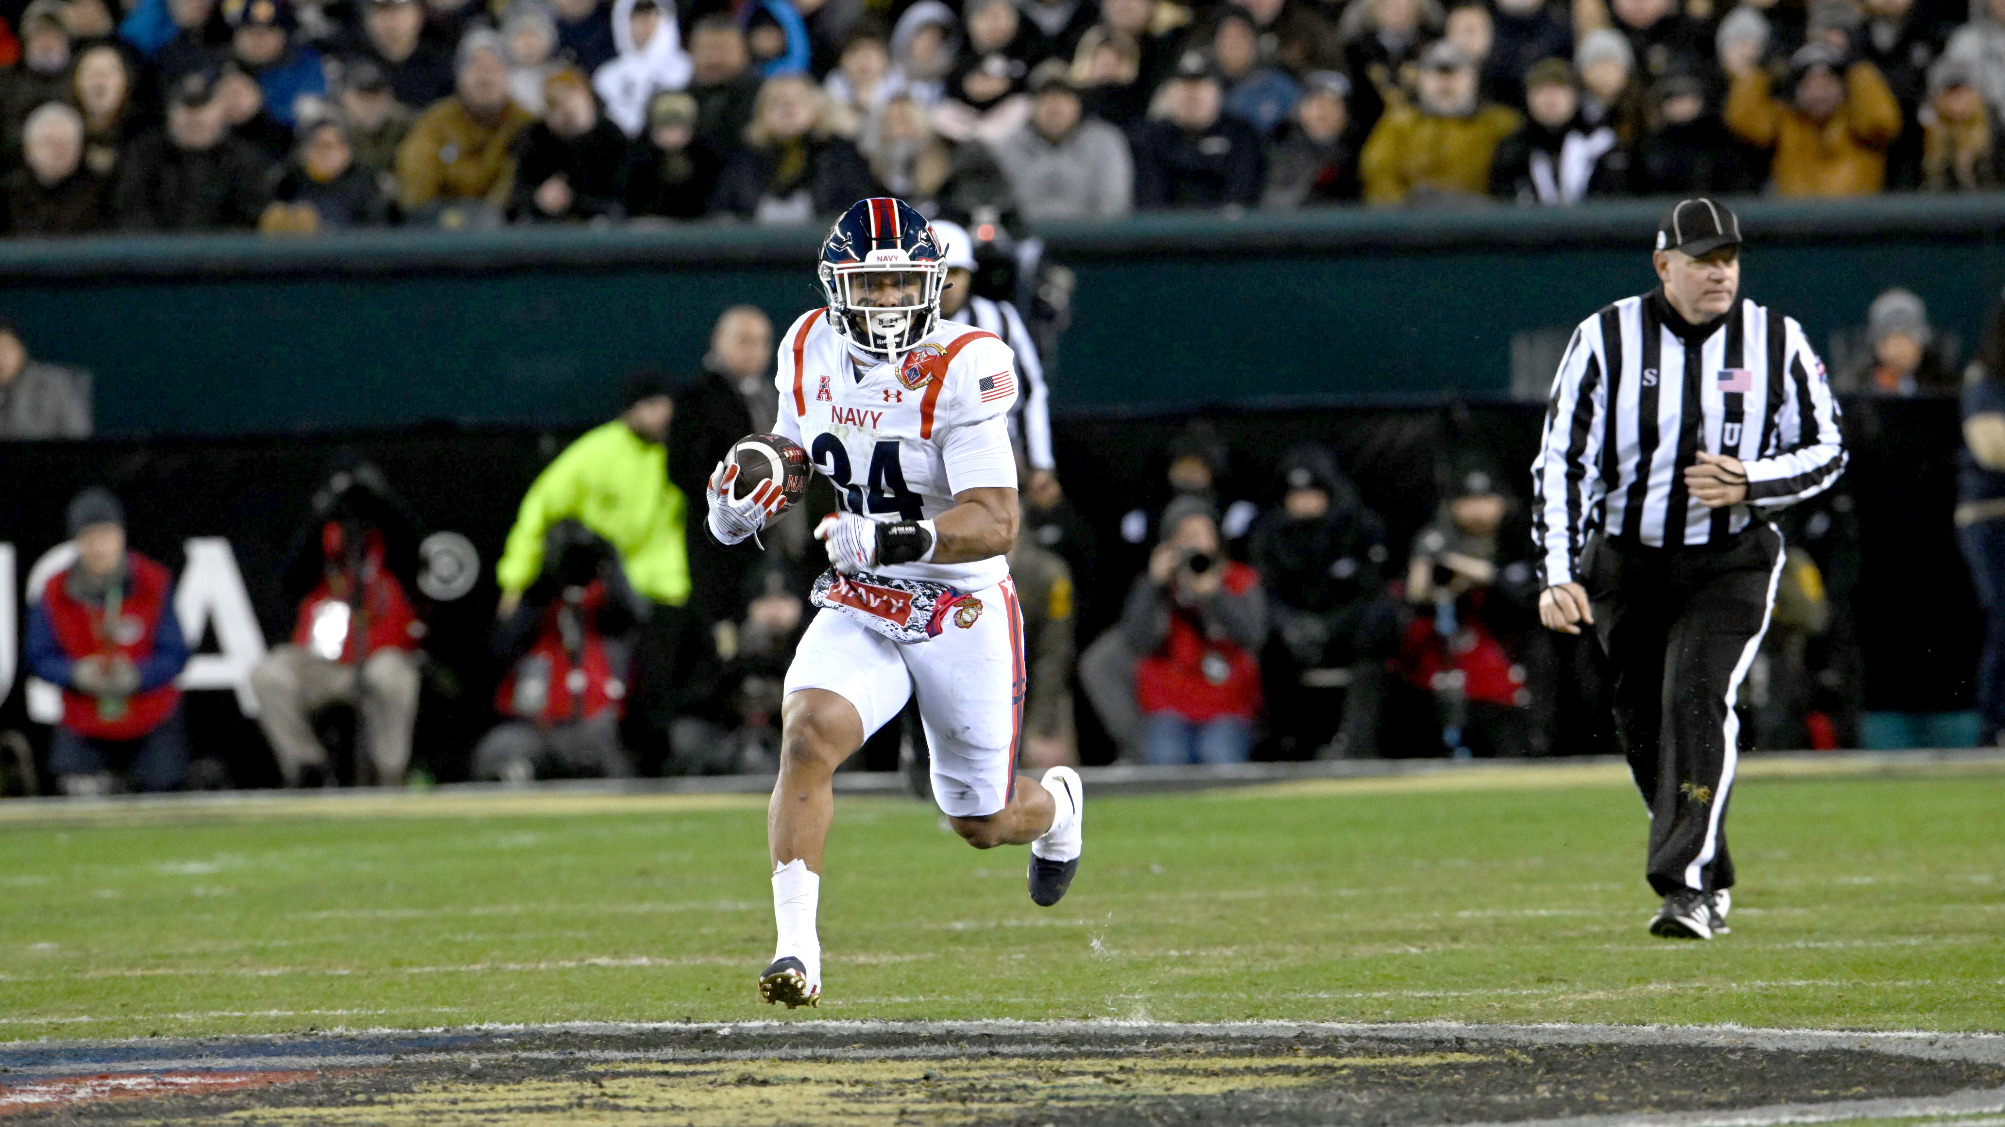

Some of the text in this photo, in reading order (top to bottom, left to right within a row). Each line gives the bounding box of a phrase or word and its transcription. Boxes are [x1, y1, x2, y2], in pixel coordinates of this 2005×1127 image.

[1643, 369, 1658, 386] S
[831, 405, 883, 430] NAVY
[1723, 423, 1742, 446] U
